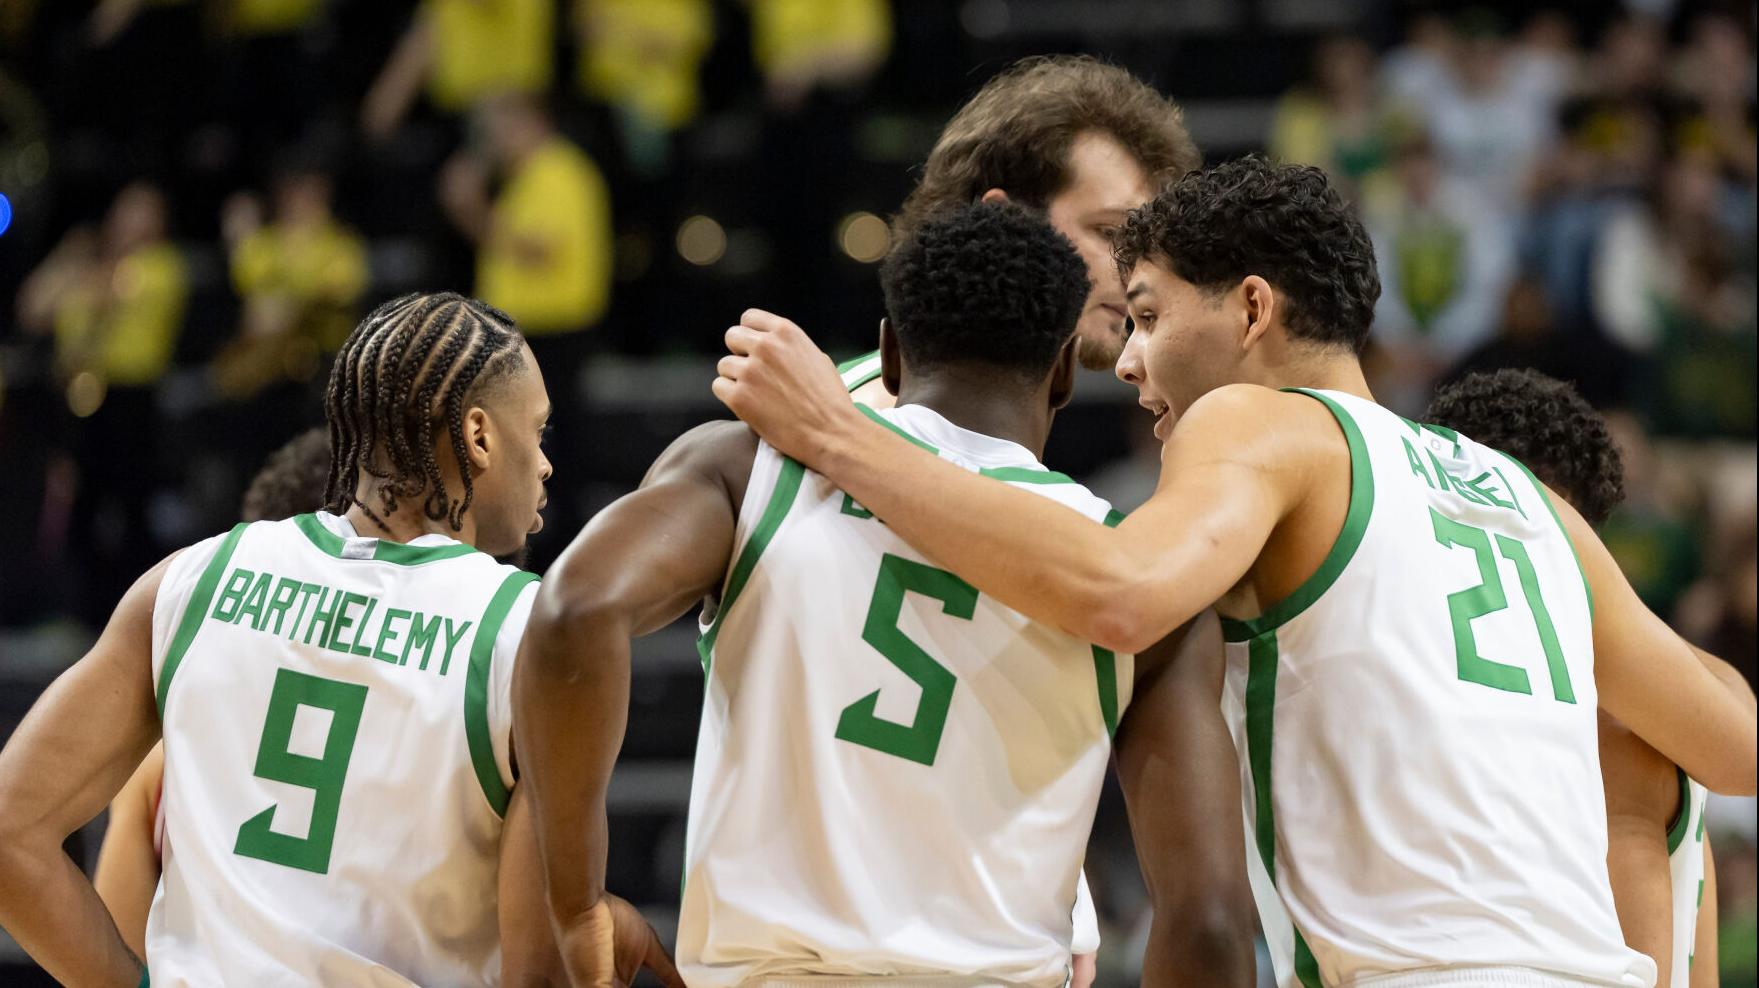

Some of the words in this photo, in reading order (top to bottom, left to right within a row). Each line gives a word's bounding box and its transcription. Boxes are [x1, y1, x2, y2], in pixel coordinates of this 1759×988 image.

[211, 568, 472, 676] BARTHELEMY
[835, 552, 980, 766] 5
[1428, 505, 1577, 705] 21
[233, 667, 369, 875] 9
